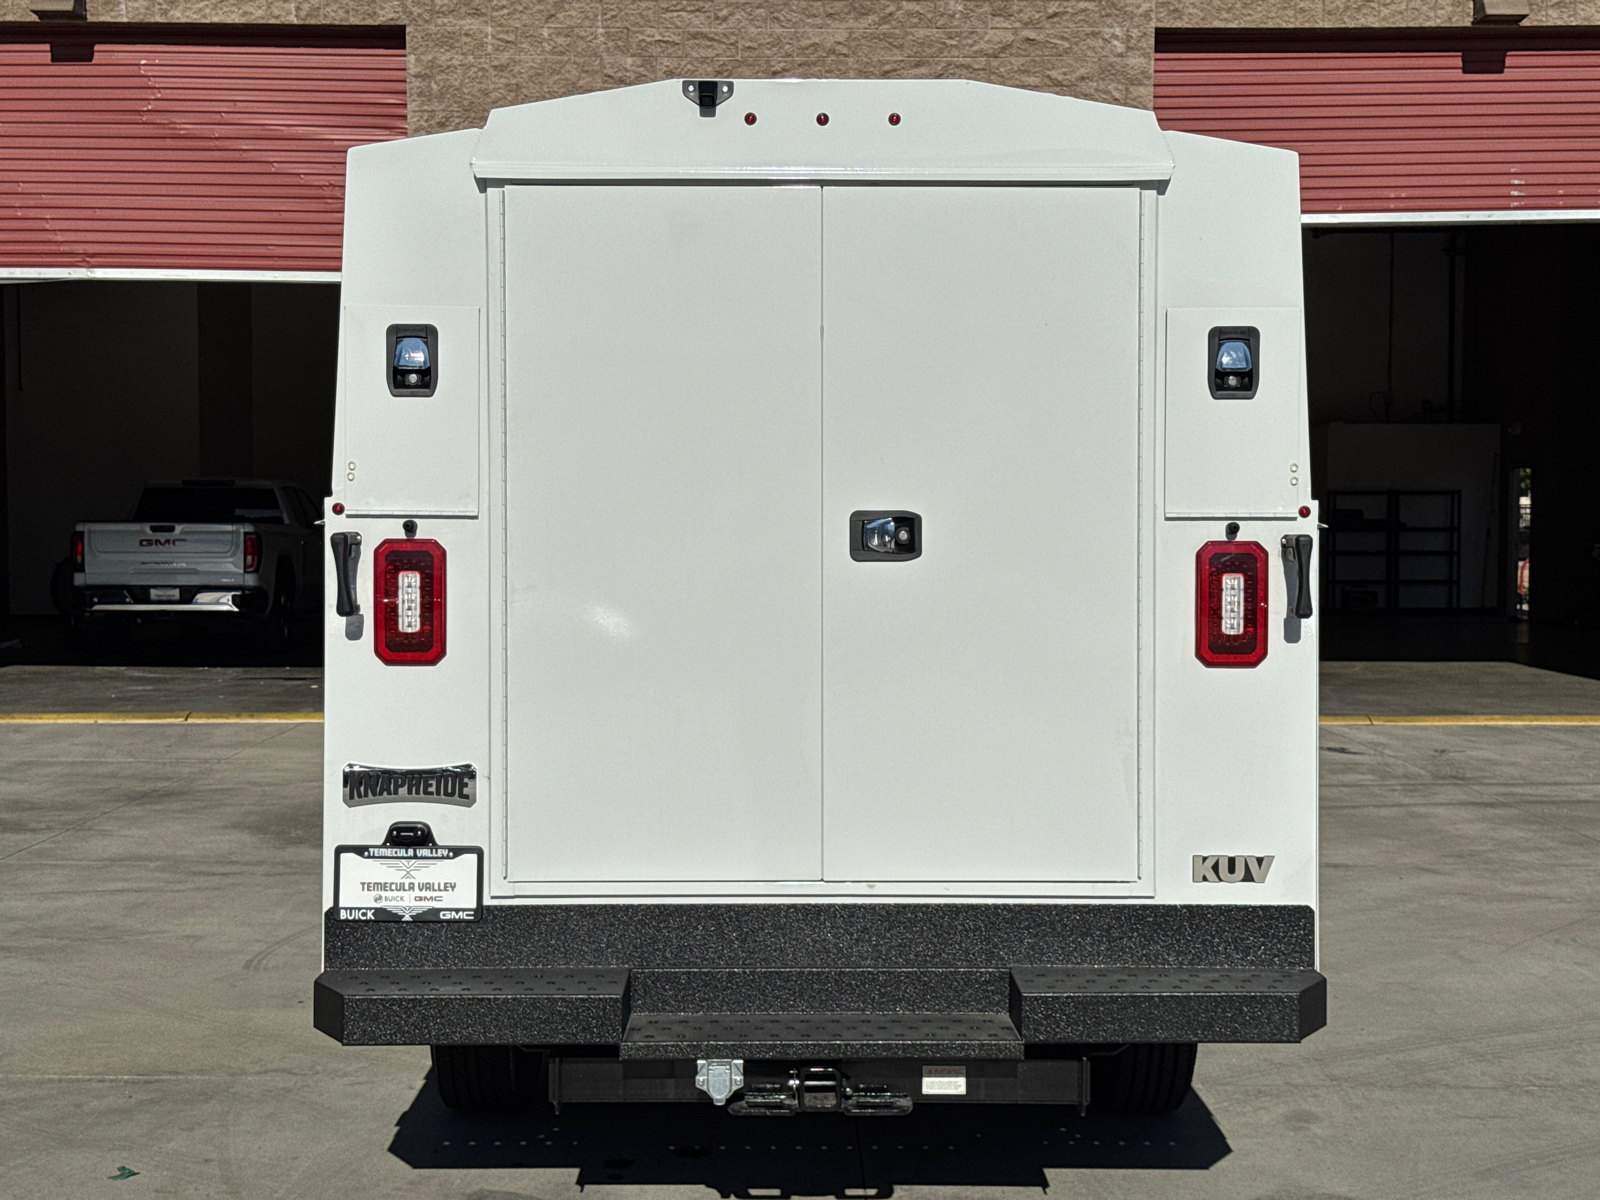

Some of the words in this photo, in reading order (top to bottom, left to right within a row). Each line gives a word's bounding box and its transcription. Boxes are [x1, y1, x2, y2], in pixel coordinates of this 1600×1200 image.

[139, 538, 187, 547] GMC
[348, 771, 470, 800] KNAPHEIDE
[369, 848, 414, 857] TEMECULA
[416, 848, 449, 858] VALLEY
[1192, 855, 1275, 883] KUV
[360, 882, 415, 892] TEMECULA
[418, 882, 456, 892] VALLEY
[340, 909, 375, 919] BUICK
[440, 911, 474, 919] GMC
